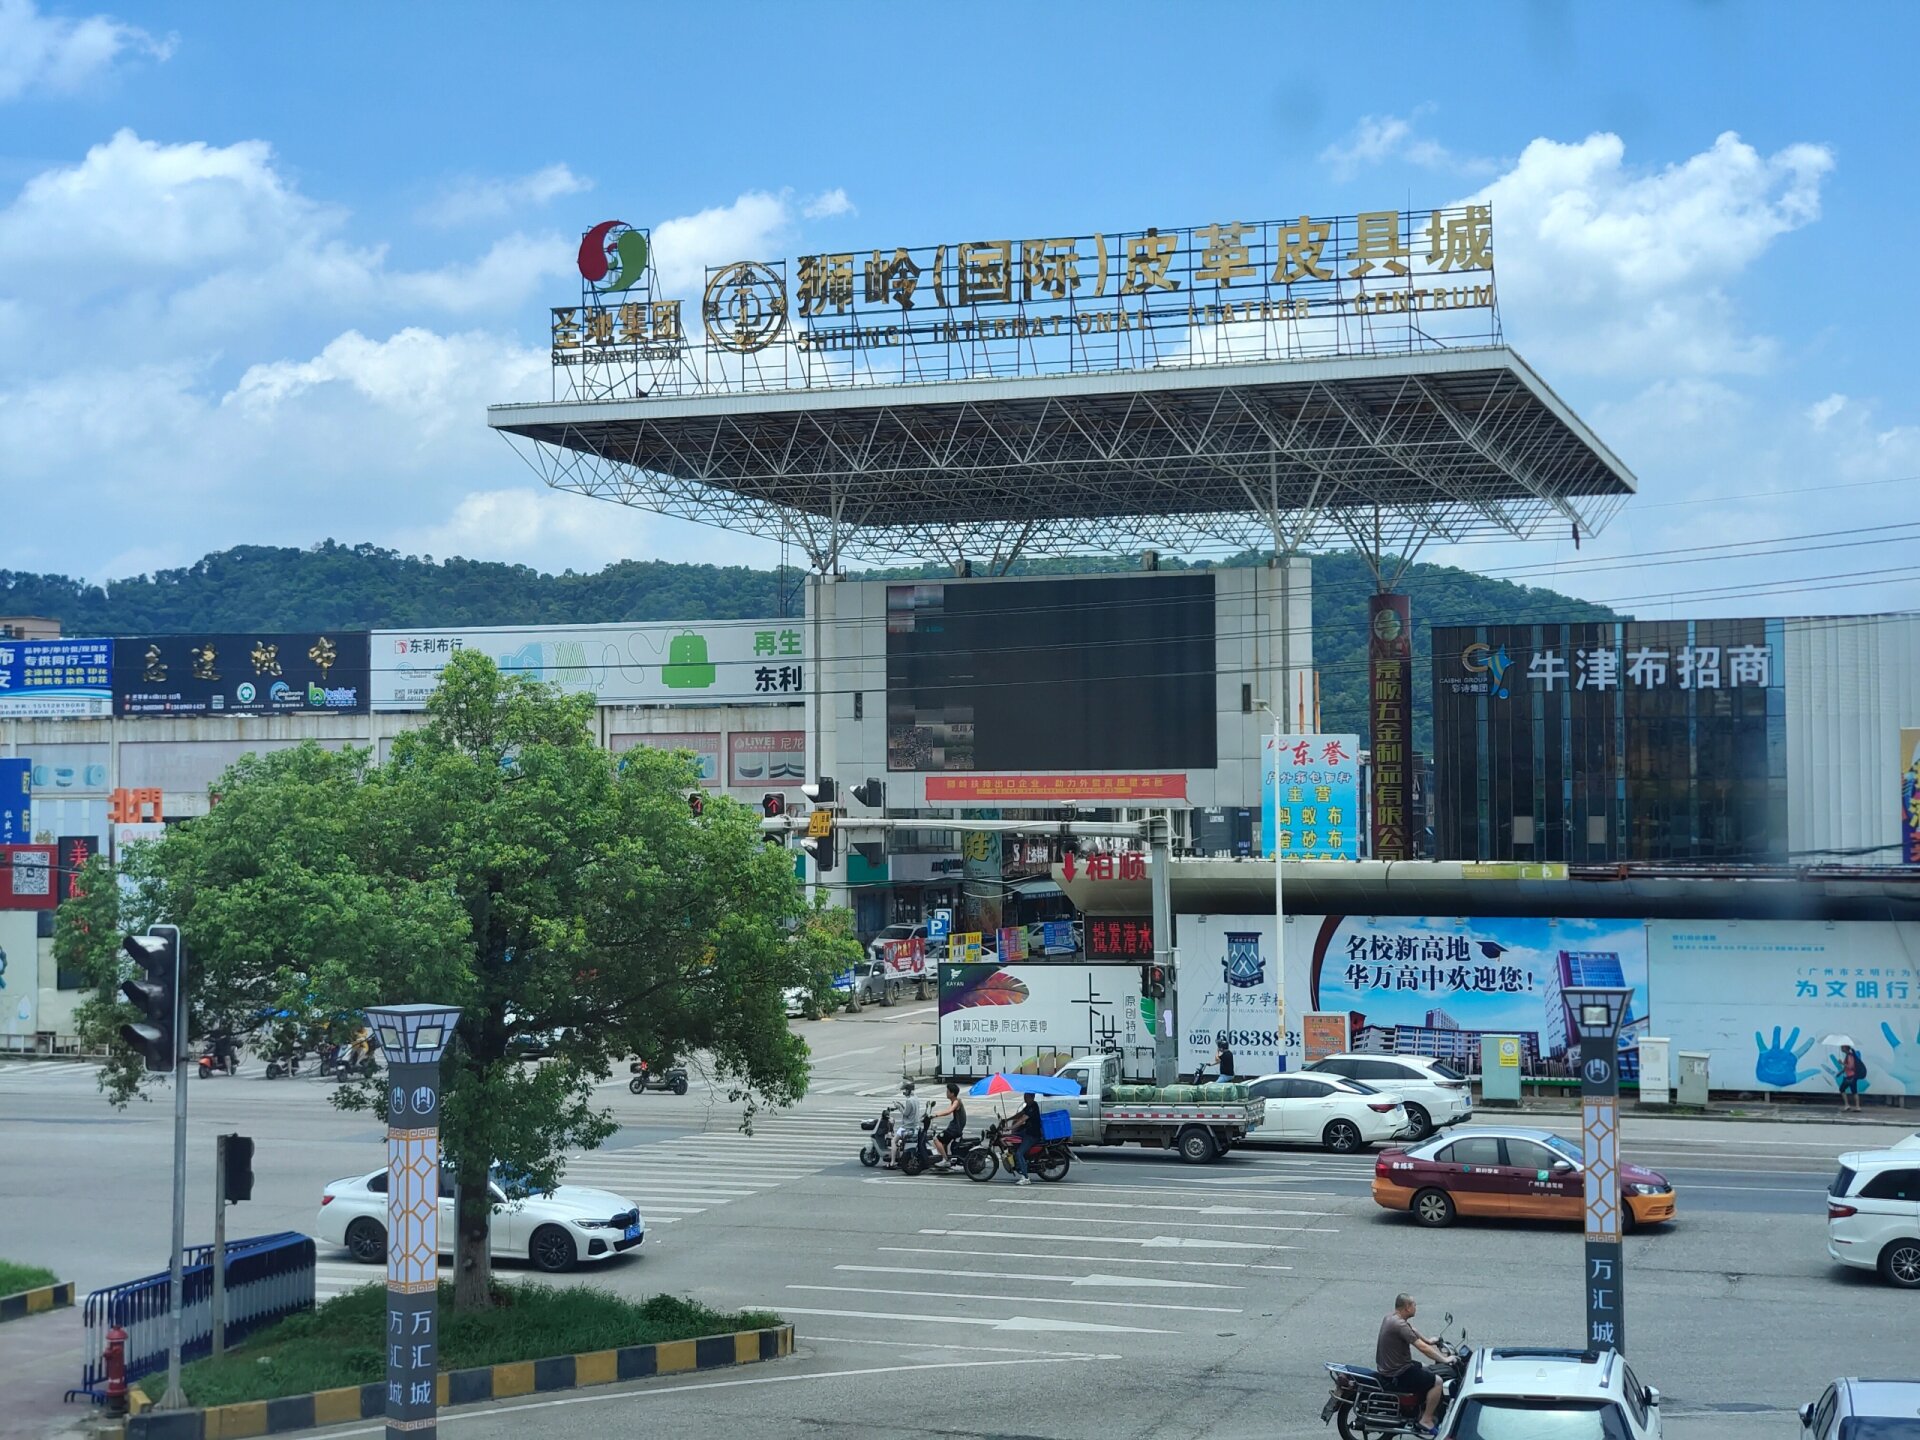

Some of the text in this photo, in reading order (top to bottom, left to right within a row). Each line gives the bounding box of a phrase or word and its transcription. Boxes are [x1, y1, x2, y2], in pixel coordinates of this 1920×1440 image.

[797, 205, 1495, 317] 狮岭(国际)皮革皮具城
[933, 308, 1149, 343] INTERNATONAL
[1189, 298, 1310, 327] LEATHER
[1355, 284, 1495, 315] CENTRUM
[410, 638, 463, 654] 东利布行
[753, 629, 802, 656] 再生
[755, 665, 803, 692] 东利
[1527, 645, 1772, 691] 牛津布招商
[1287, 785, 1331, 802] 主营
[1086, 850, 1146, 880] 柏顺
[931, 920, 942, 934] P
[1344, 934, 1471, 961] 名校新高地
[1344, 964, 1533, 991] 华万高中欢迎您!
[1125, 996, 1136, 1043] 原创特材
[1188, 1034, 1211, 1045] 020
[1591, 1258, 1615, 1343] 万汇城
[389, 1310, 404, 1406] 万汇城
[410, 1310, 433, 1406] 万汇城
